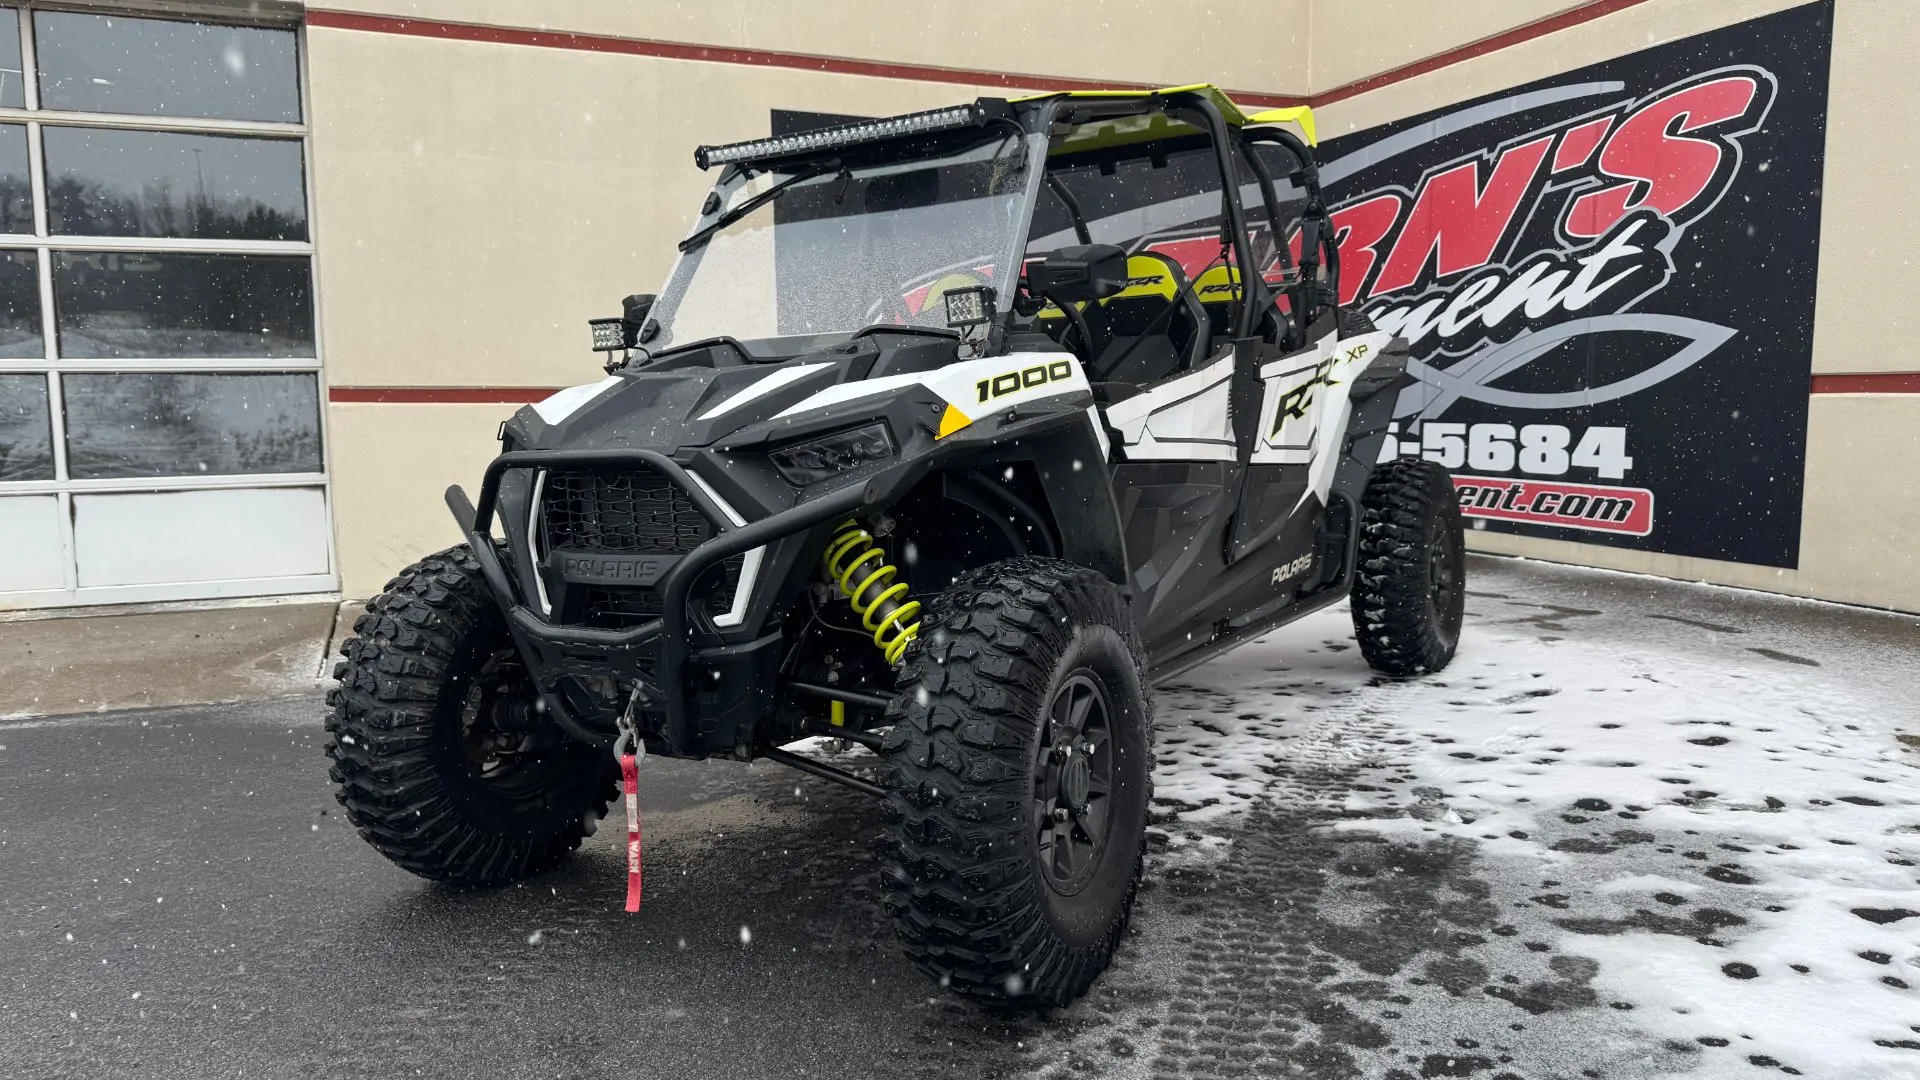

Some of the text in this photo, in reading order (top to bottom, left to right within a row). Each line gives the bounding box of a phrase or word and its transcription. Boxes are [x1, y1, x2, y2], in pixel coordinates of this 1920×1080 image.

[1366, 219, 1648, 346] ment
[1345, 344, 1368, 363] XP
[976, 360, 1072, 404] 1000
[1456, 482, 1635, 523] ent.com
[563, 558, 658, 579] POLARIS
[1270, 552, 1313, 586] POLARIS
[628, 841, 640, 873] WARN
